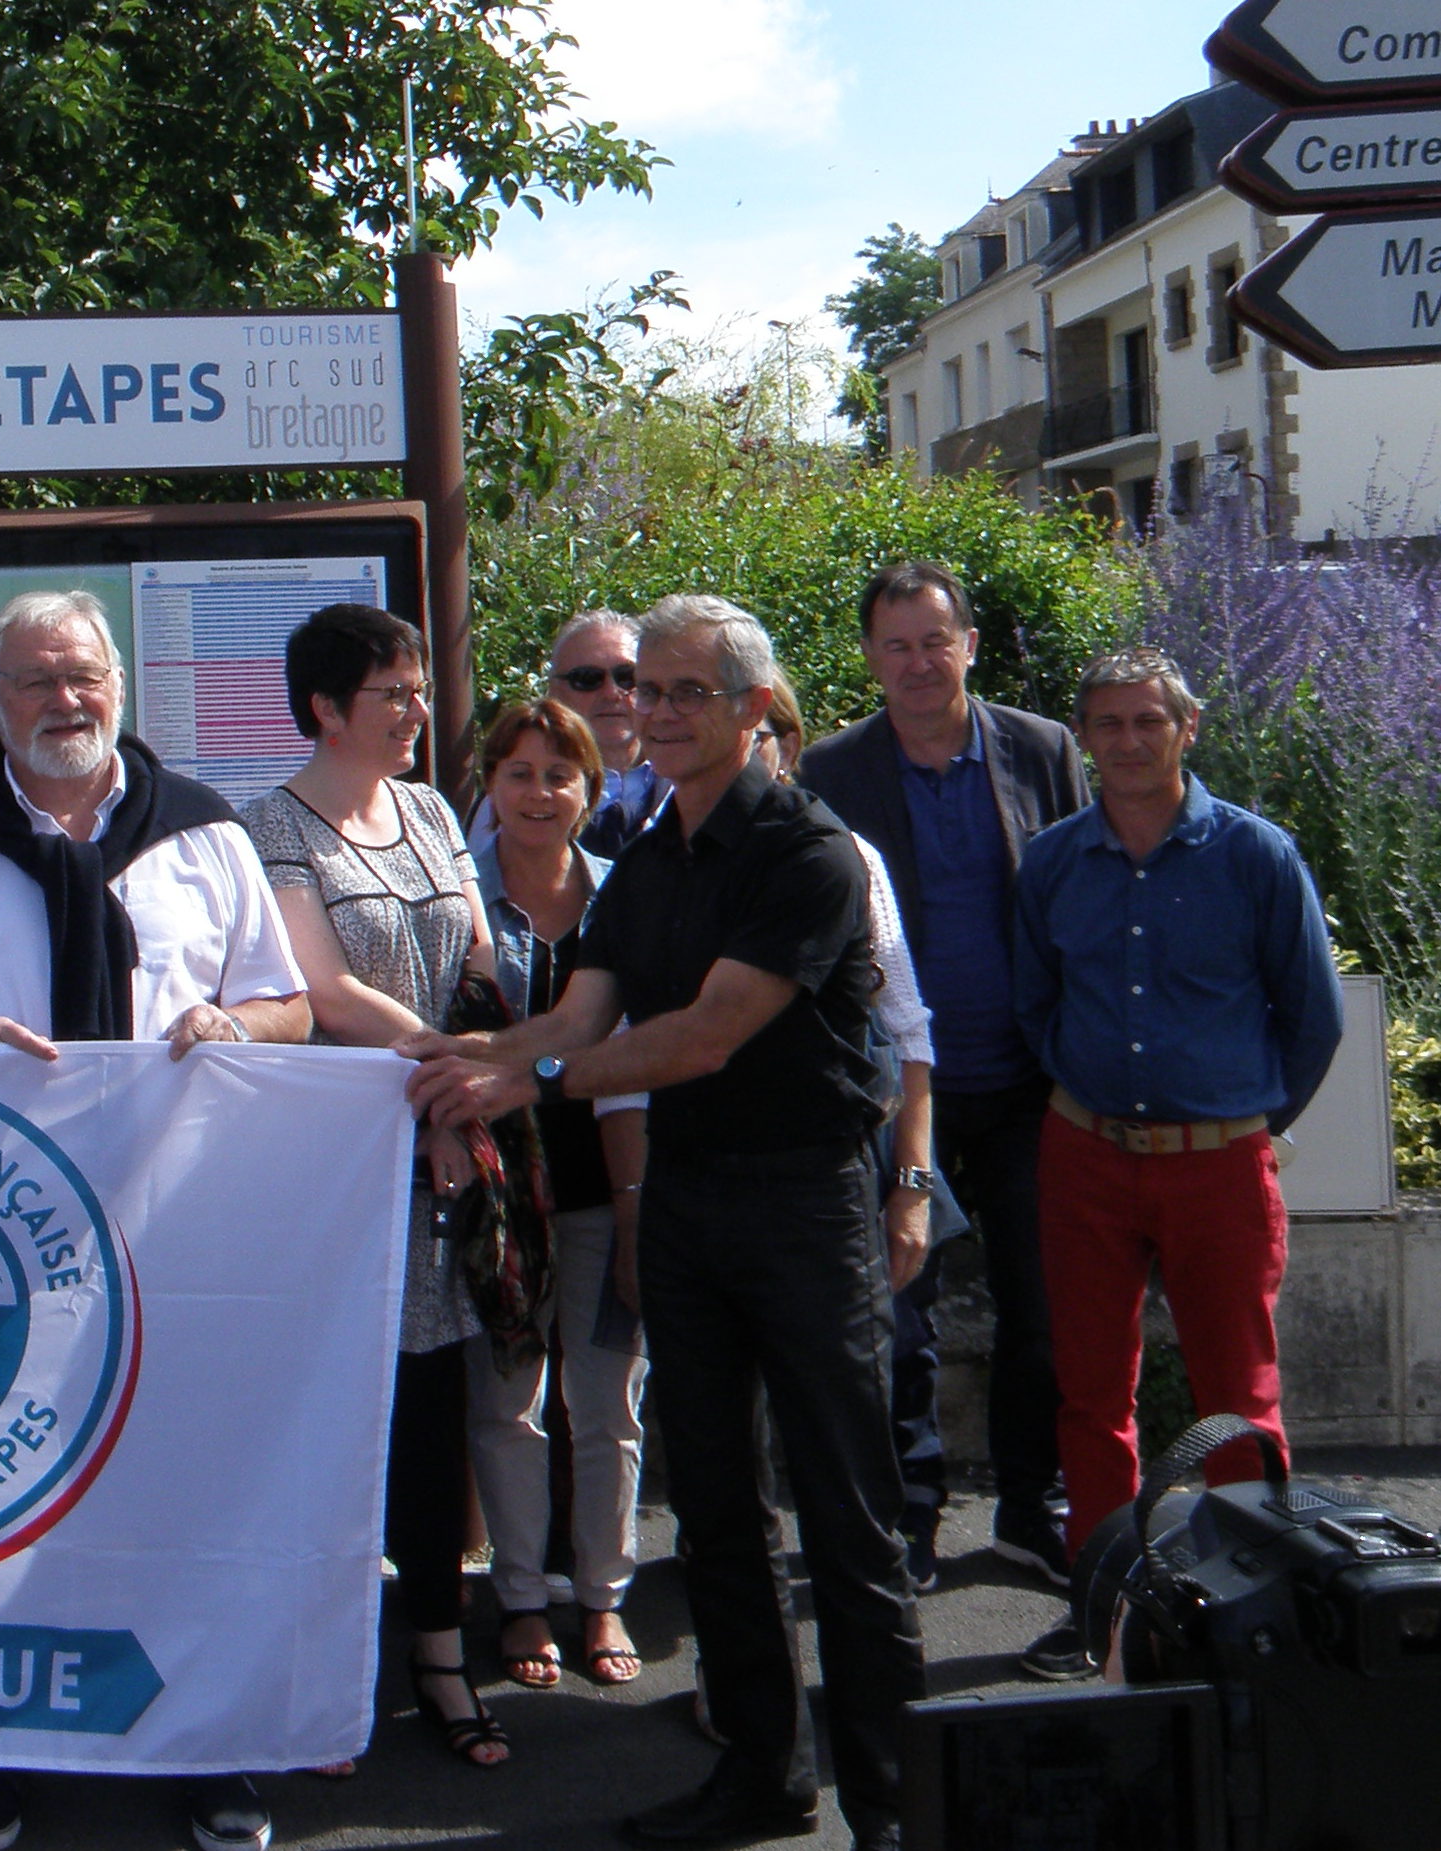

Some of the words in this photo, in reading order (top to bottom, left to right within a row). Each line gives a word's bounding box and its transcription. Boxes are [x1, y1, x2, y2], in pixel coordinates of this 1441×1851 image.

[1296, 134, 1441, 174] Centre
[242, 324, 382, 347] TOURISME
[245, 359, 300, 388] arc
[329, 352, 384, 387] sud
[246, 394, 386, 460] bretagne
